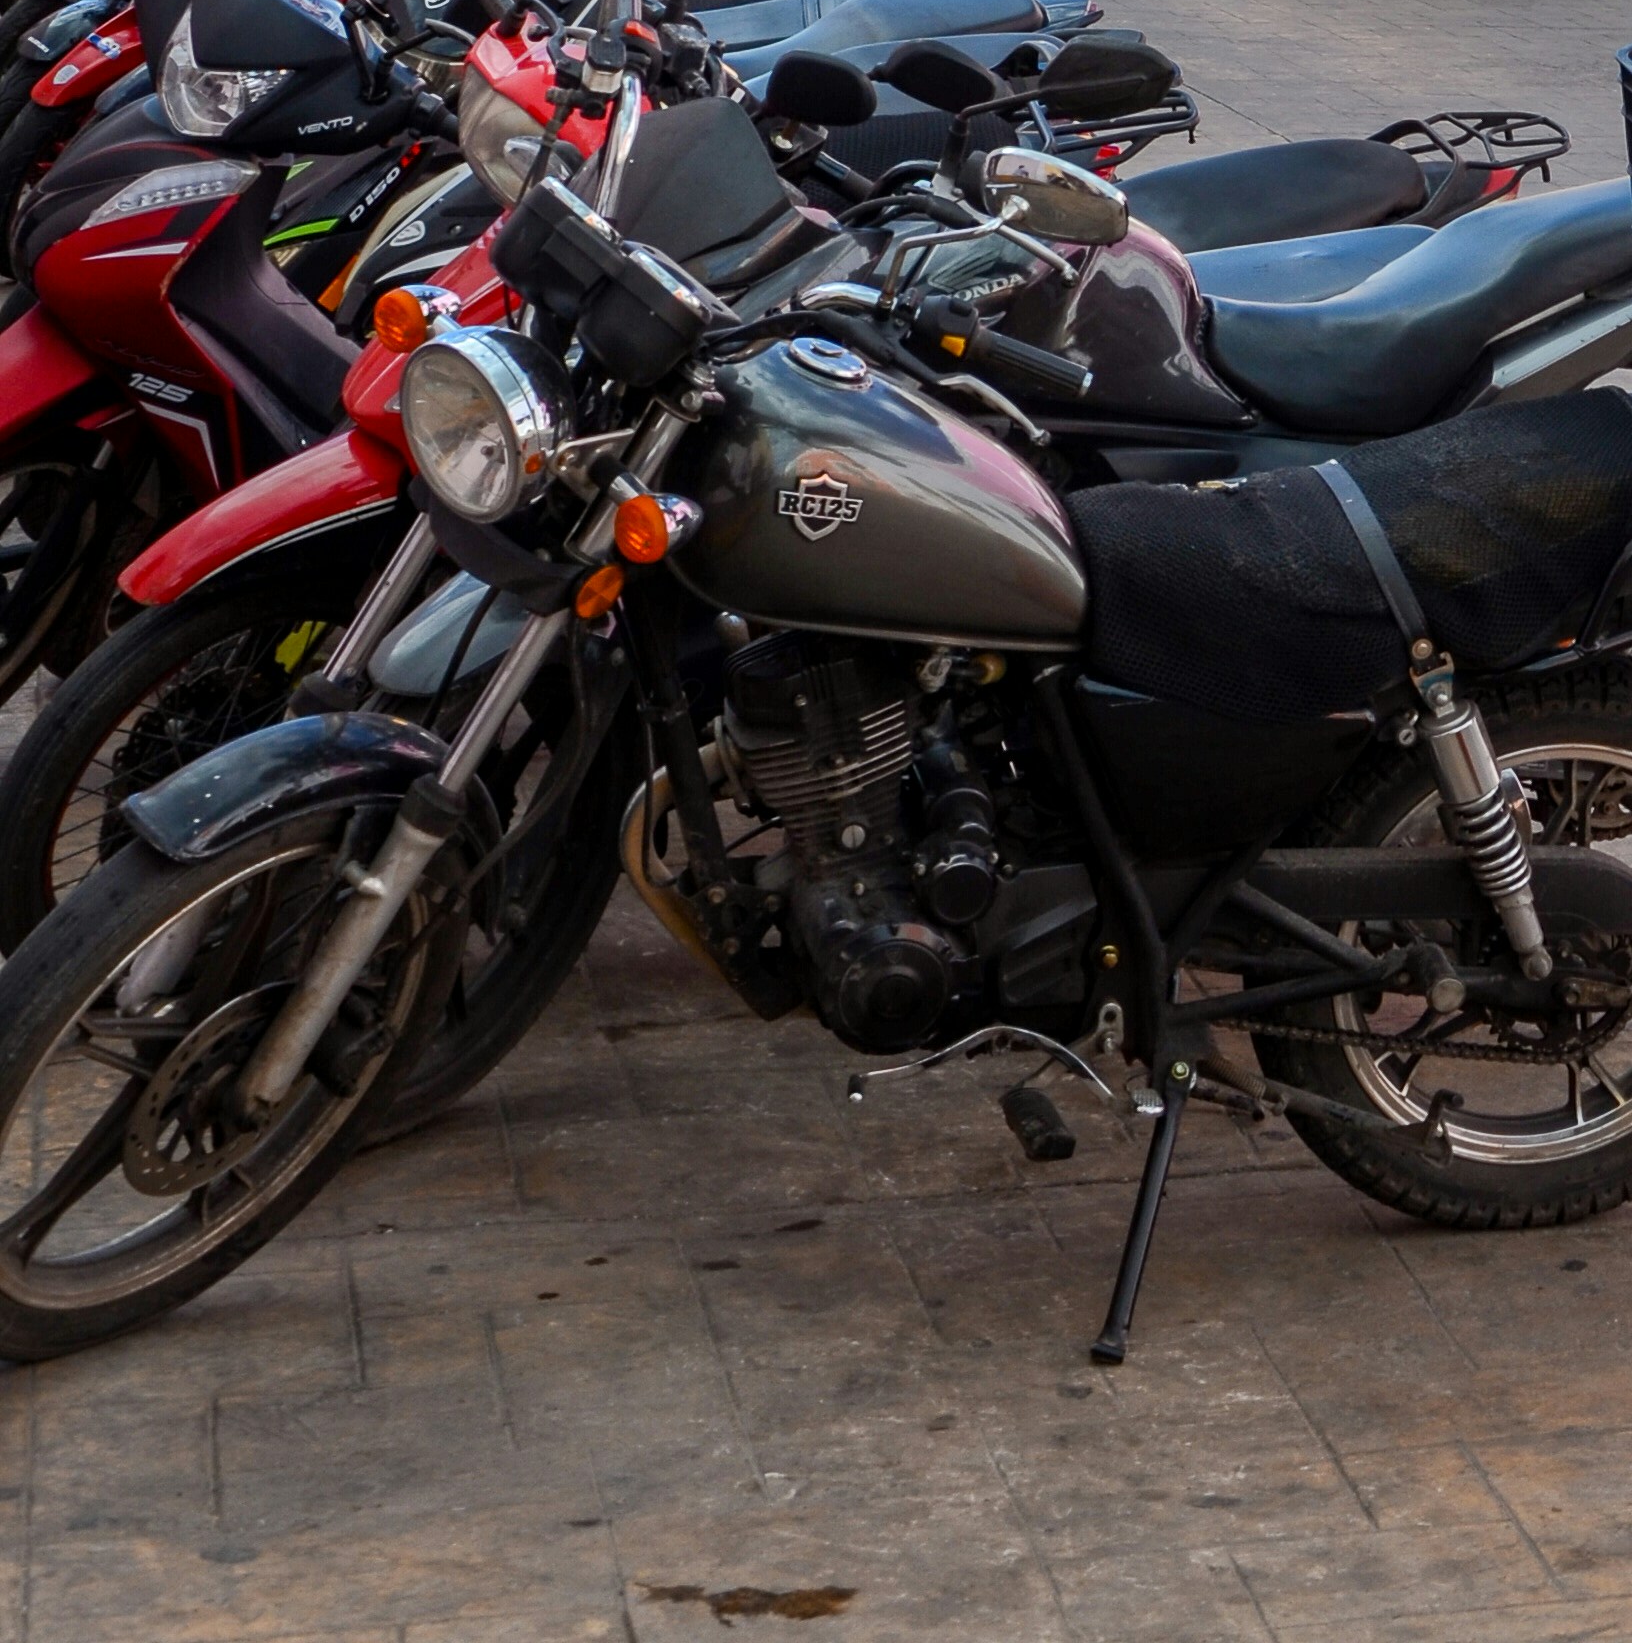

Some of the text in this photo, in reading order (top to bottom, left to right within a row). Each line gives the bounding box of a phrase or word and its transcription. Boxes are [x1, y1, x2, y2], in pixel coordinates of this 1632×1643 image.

[297, 115, 354, 135] VENTO
[949, 273, 1028, 302] ONDA
[128, 373, 195, 404] 125
[781, 493, 860, 520] RC125
